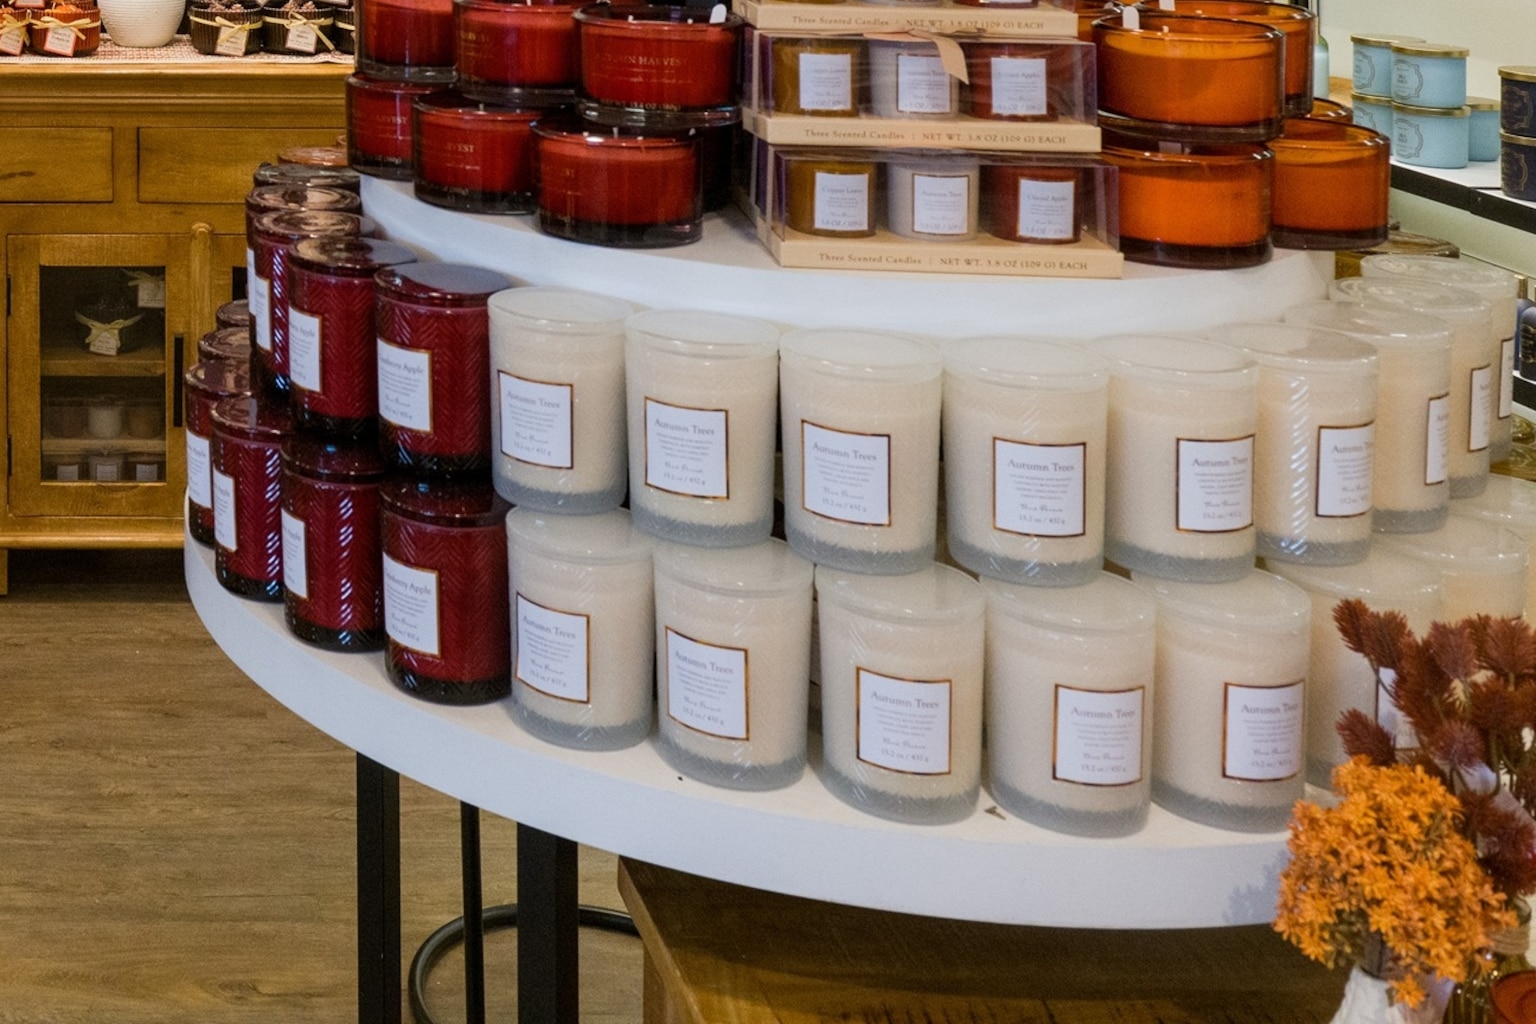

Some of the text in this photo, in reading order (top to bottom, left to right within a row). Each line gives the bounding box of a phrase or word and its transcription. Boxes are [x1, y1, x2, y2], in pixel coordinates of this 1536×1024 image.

[820, 16, 852, 25] Scented
[855, 17, 889, 26] Candles
[906, 19, 925, 27] NET
[1017, 22, 1044, 30] EACH
[638, 56, 688, 66] HARVEST
[804, 129, 829, 137] Three
[832, 129, 866, 138] Scented
[869, 130, 905, 139] Candles
[923, 133, 942, 141] NET
[1038, 135, 1067, 144] EACH
[819, 253, 845, 261] Three
[848, 254, 883, 263] Scented
[885, 255, 922, 264] Candles
[940, 258, 959, 266] NET
[1003, 260, 1017, 268] OZ
[1059, 262, 1087, 270] EACH
[403, 362, 424, 374] Apple
[506, 391, 560, 409] Autumn Trees
[654, 418, 715, 436] Autumn Trees
[812, 442, 877, 461] Autumn Trees
[1007, 459, 1075, 473] Autumn Trees
[1192, 458, 1230, 467] Autumn
[409, 581, 431, 595] Apple
[522, 615, 576, 639] Autumn Trees
[675, 650, 734, 675] Autumn Trees
[870, 691, 939, 710] Autumn Trees
[1070, 707, 1136, 719] Autumn Trees
[1241, 704, 1281, 714] Autumn
